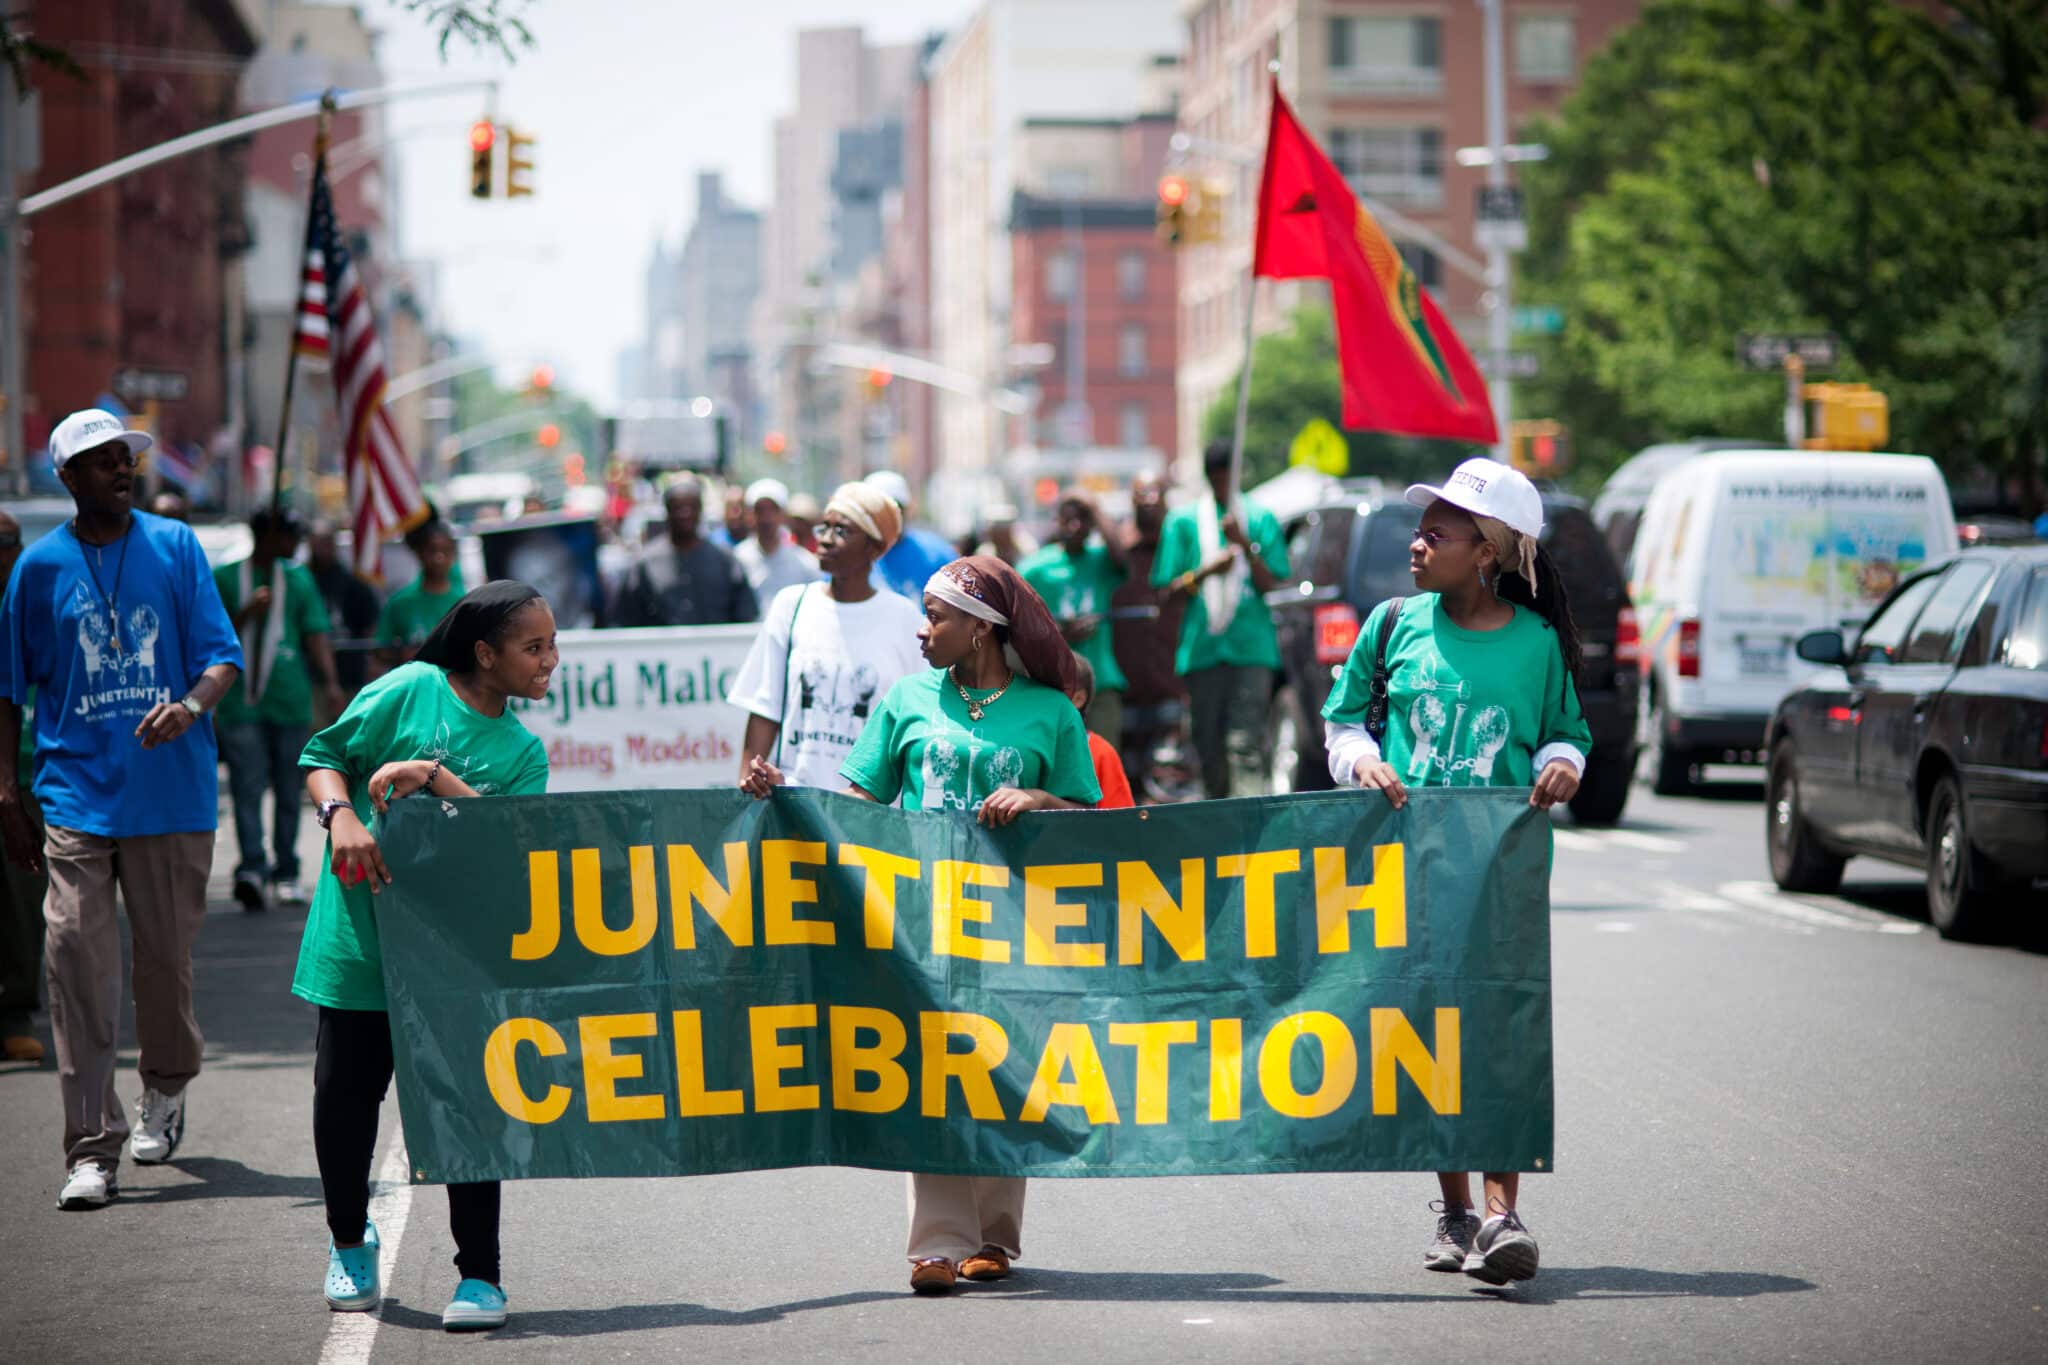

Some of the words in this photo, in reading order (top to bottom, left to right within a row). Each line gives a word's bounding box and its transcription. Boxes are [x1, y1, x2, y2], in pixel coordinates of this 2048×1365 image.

[74, 686, 170, 715] JUNETEENTH
[626, 730, 733, 763] Models
[511, 839, 1407, 967] JUNETEENTH
[483, 1004, 1462, 1125] CELEBRATION
